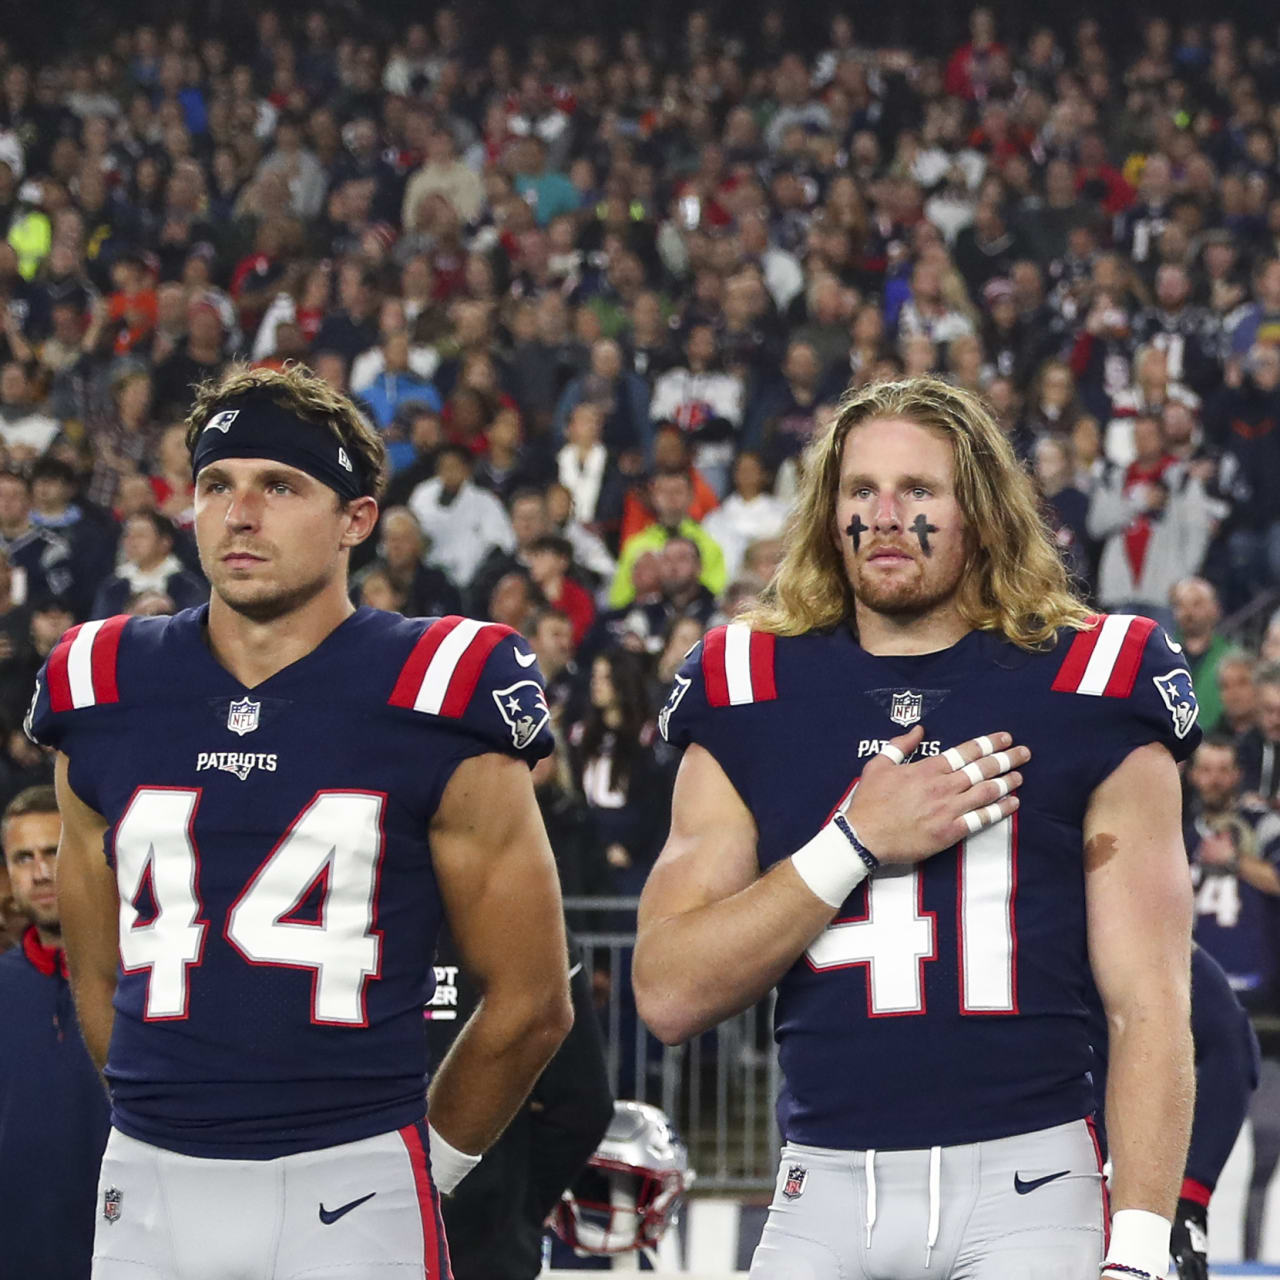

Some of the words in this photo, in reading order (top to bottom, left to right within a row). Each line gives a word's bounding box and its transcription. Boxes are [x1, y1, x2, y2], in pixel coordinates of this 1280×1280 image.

[857, 739, 941, 758] PATTS
[196, 752, 278, 772] PATRIOTS
[112, 785, 389, 1028] 44
[801, 777, 1020, 1018] 41
[1190, 873, 1242, 926] 4
[432, 965, 459, 986] PT
[424, 985, 458, 1006] ER
